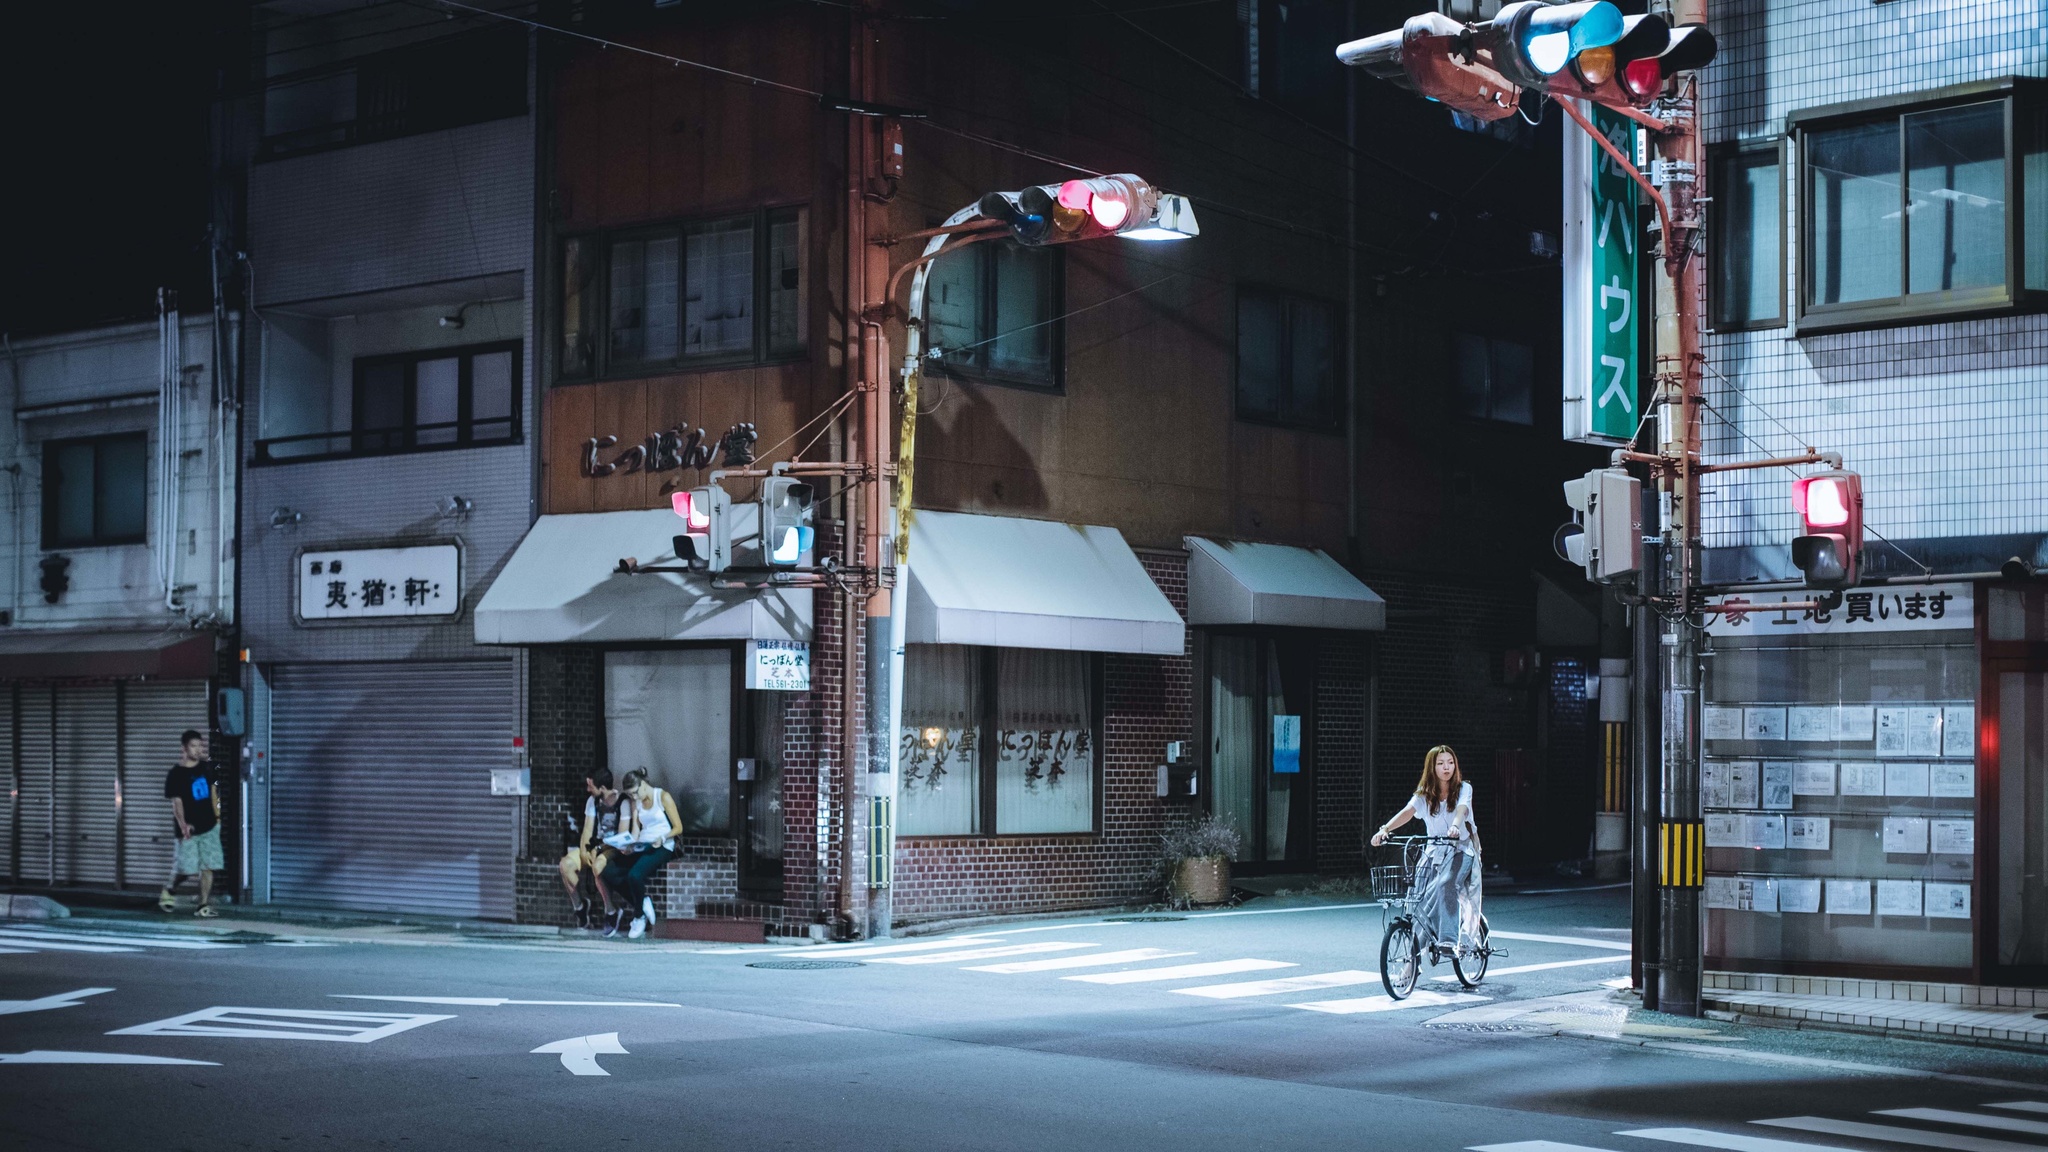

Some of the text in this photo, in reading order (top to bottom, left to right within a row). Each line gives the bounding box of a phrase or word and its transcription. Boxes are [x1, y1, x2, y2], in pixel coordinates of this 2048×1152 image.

[760, 654, 804, 666] にっぽん堂
